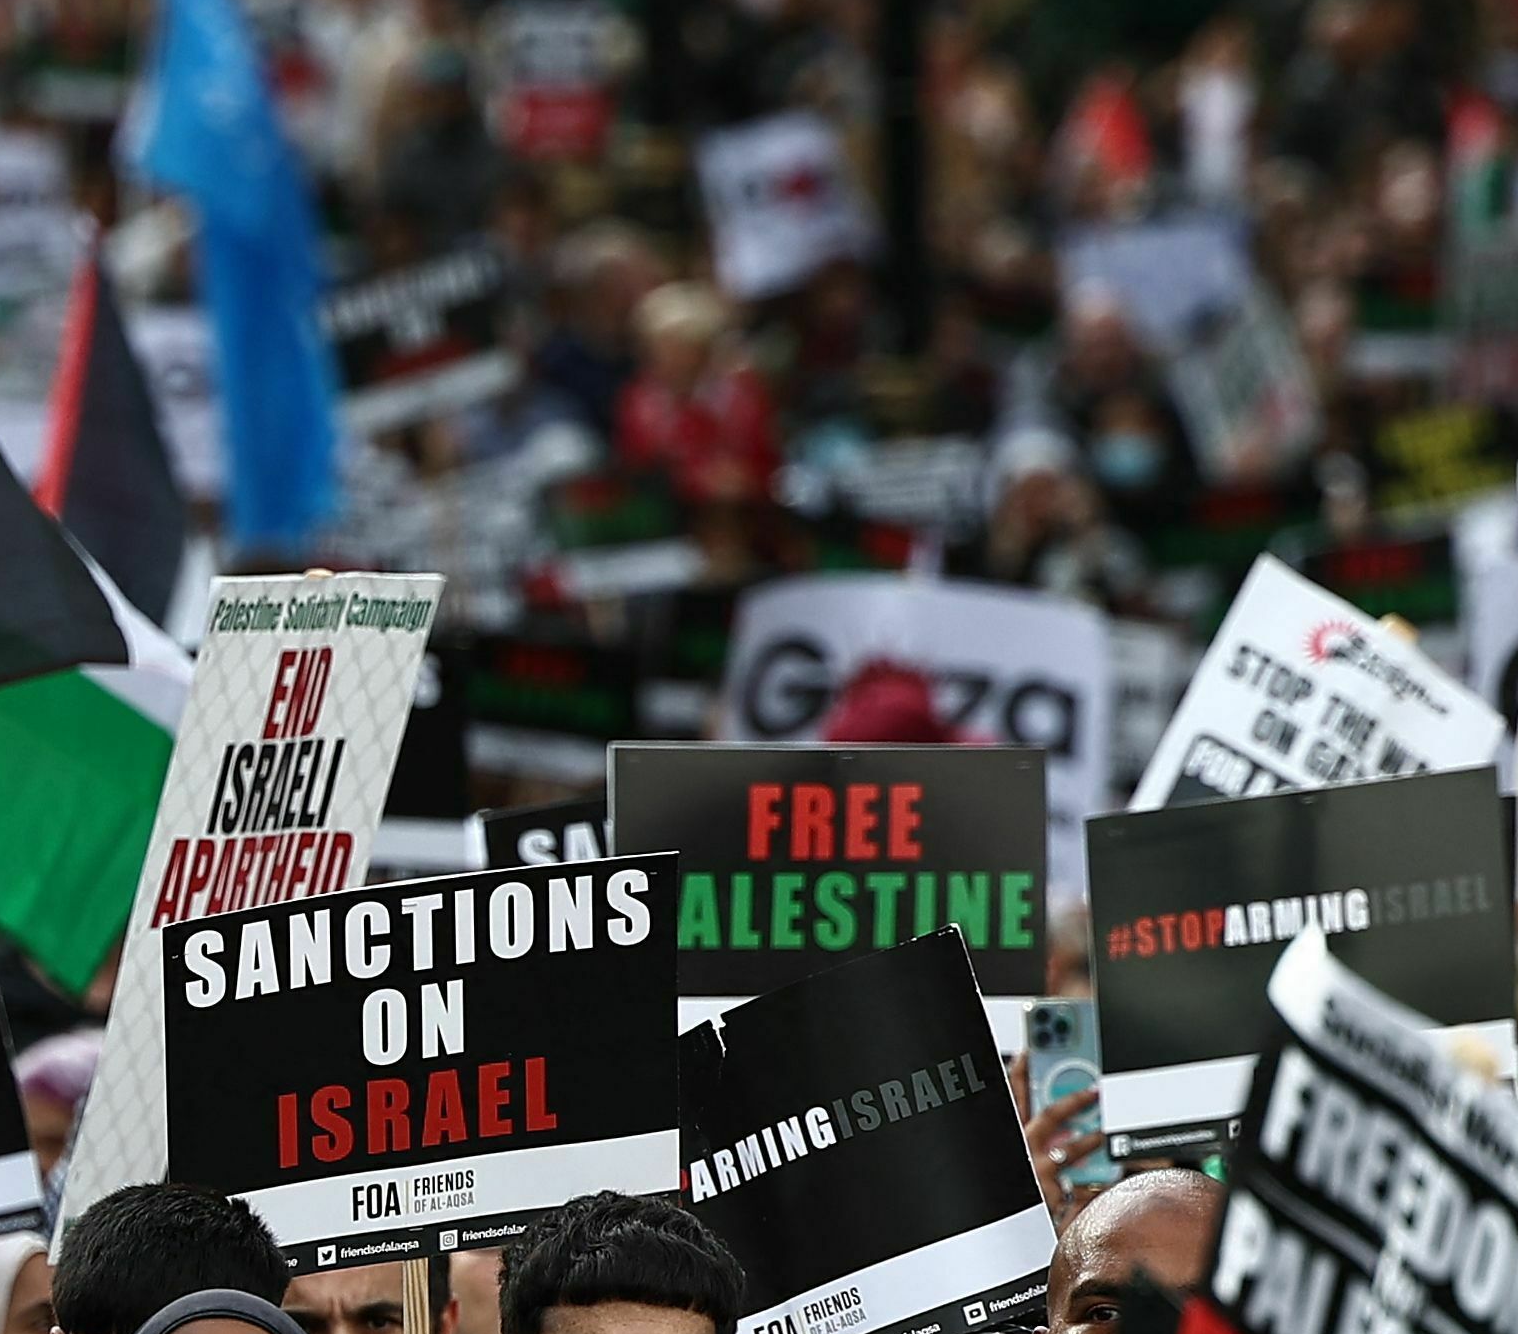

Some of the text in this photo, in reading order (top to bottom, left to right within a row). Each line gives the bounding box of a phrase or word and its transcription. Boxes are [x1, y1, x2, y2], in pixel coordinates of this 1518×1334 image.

[212, 592, 433, 634] Palestine Solidarity Campaign
[261, 645, 335, 740] END
[744, 637, 1080, 759] Gza
[206, 738, 346, 835] ISRAELI
[747, 782, 923, 862] FREE
[150, 831, 355, 929] APARTHEID
[678, 871, 1035, 951] ALESTINE
[184, 867, 652, 1009] SANCTIONS
[362, 977, 466, 1067] ON
[276, 1057, 558, 1169] ISRAEL
[680, 1053, 987, 1205] ARMINGISRAEL
[351, 1169, 475, 1222] FOA FRIENDS
[414, 1190, 475, 1214] OF AL-AQSA
[340, 1223, 528, 1259] friendsofalaqsa friendsofala
[803, 1286, 862, 1325] FRIENDS
[988, 1283, 1048, 1314] friendsofala
